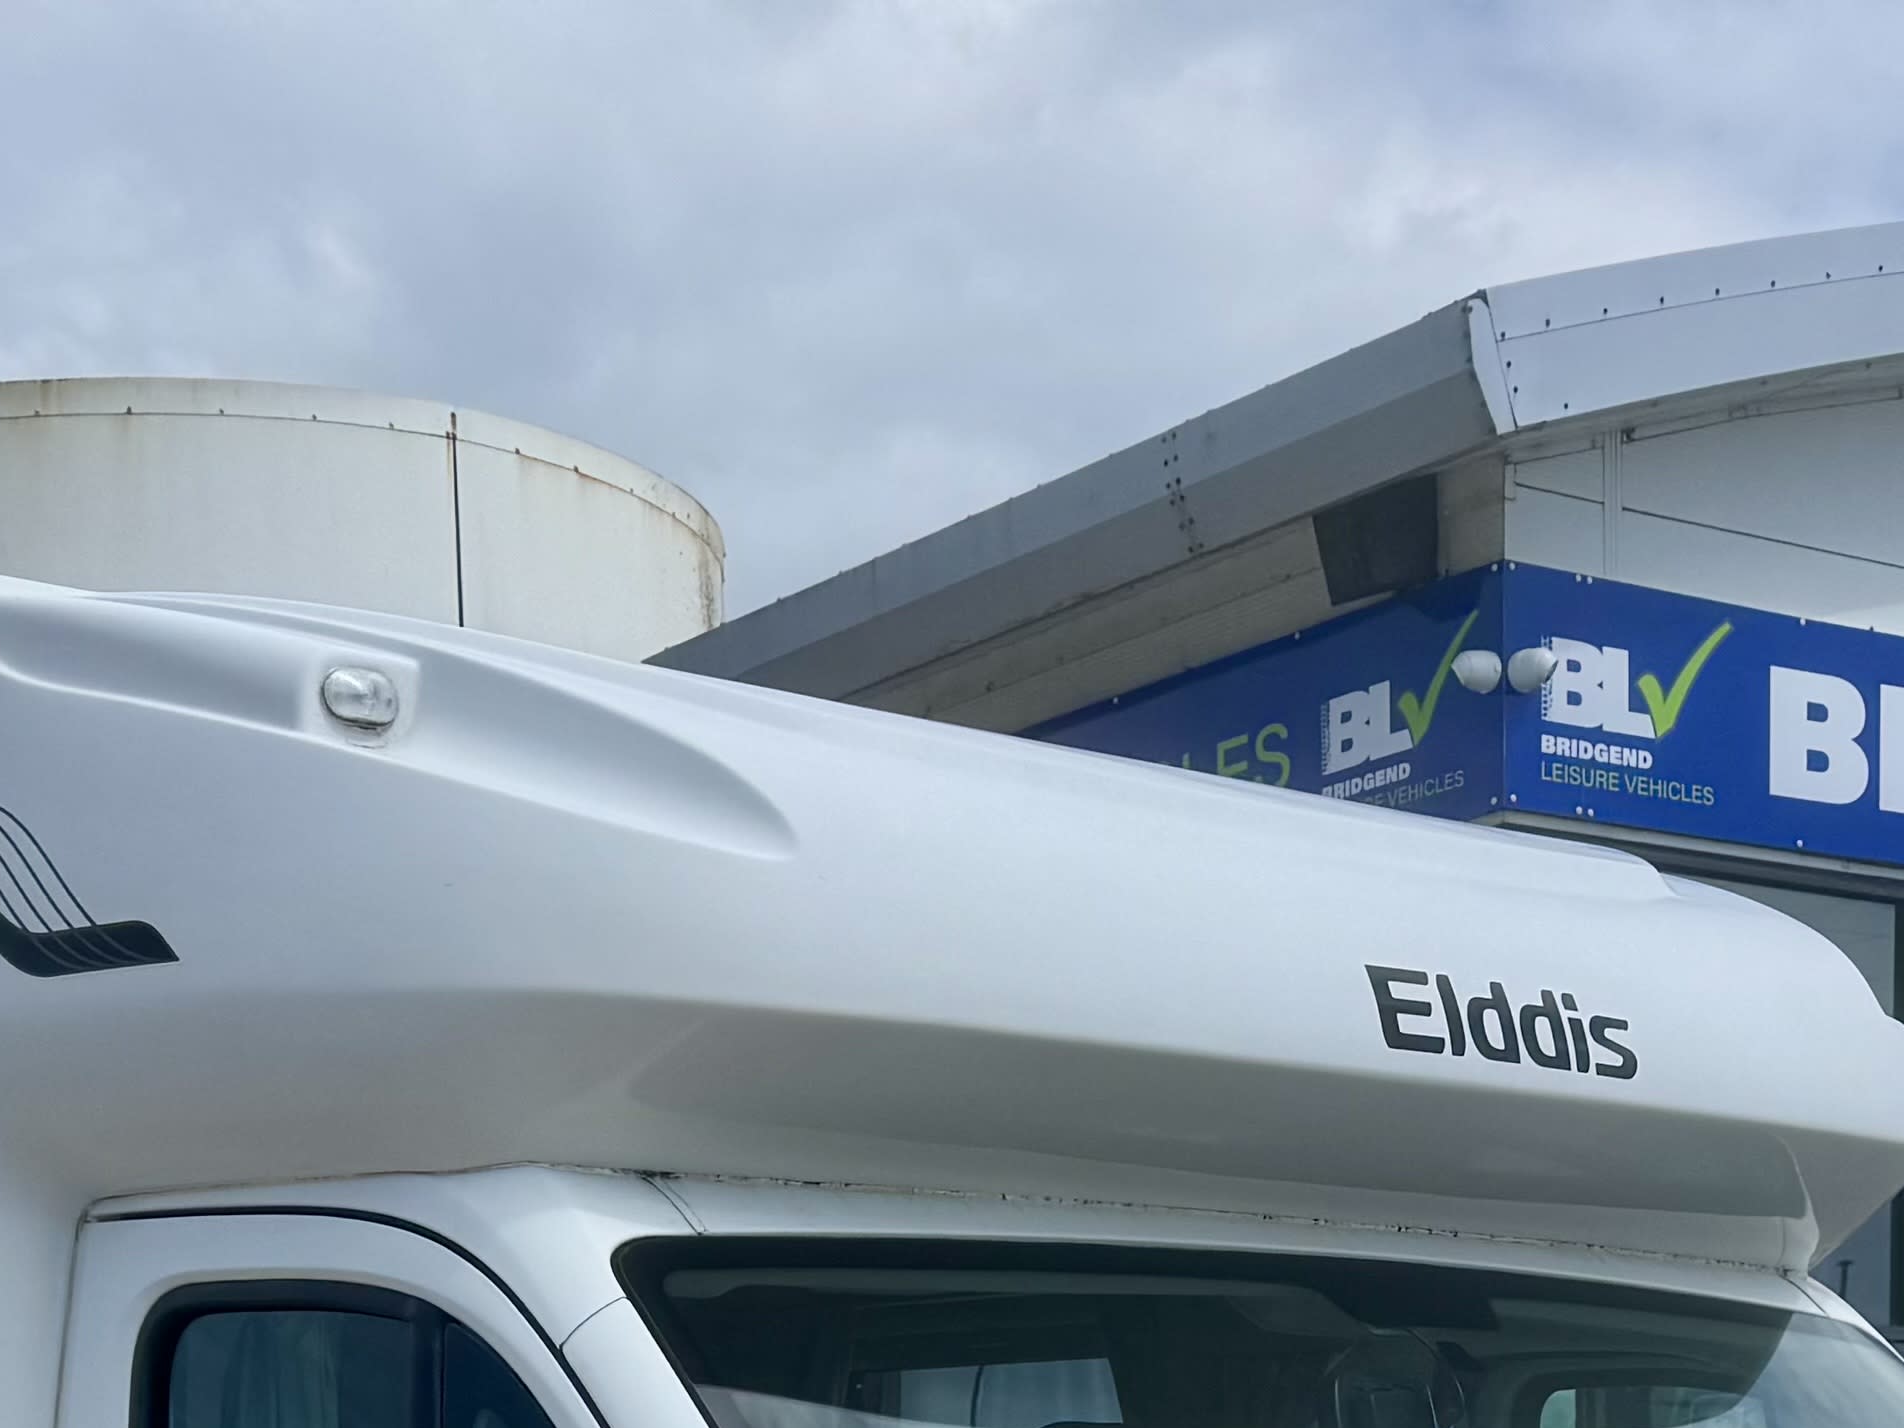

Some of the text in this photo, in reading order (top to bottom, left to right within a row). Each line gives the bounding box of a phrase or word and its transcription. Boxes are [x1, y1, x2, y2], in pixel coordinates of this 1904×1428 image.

[1541, 734, 1653, 770] BRIDGEND
[1387, 770, 1465, 807] VEHICLES
[1541, 761, 1715, 805] LEISURE VEHICLES
[1364, 963, 1638, 1080] Elddis
